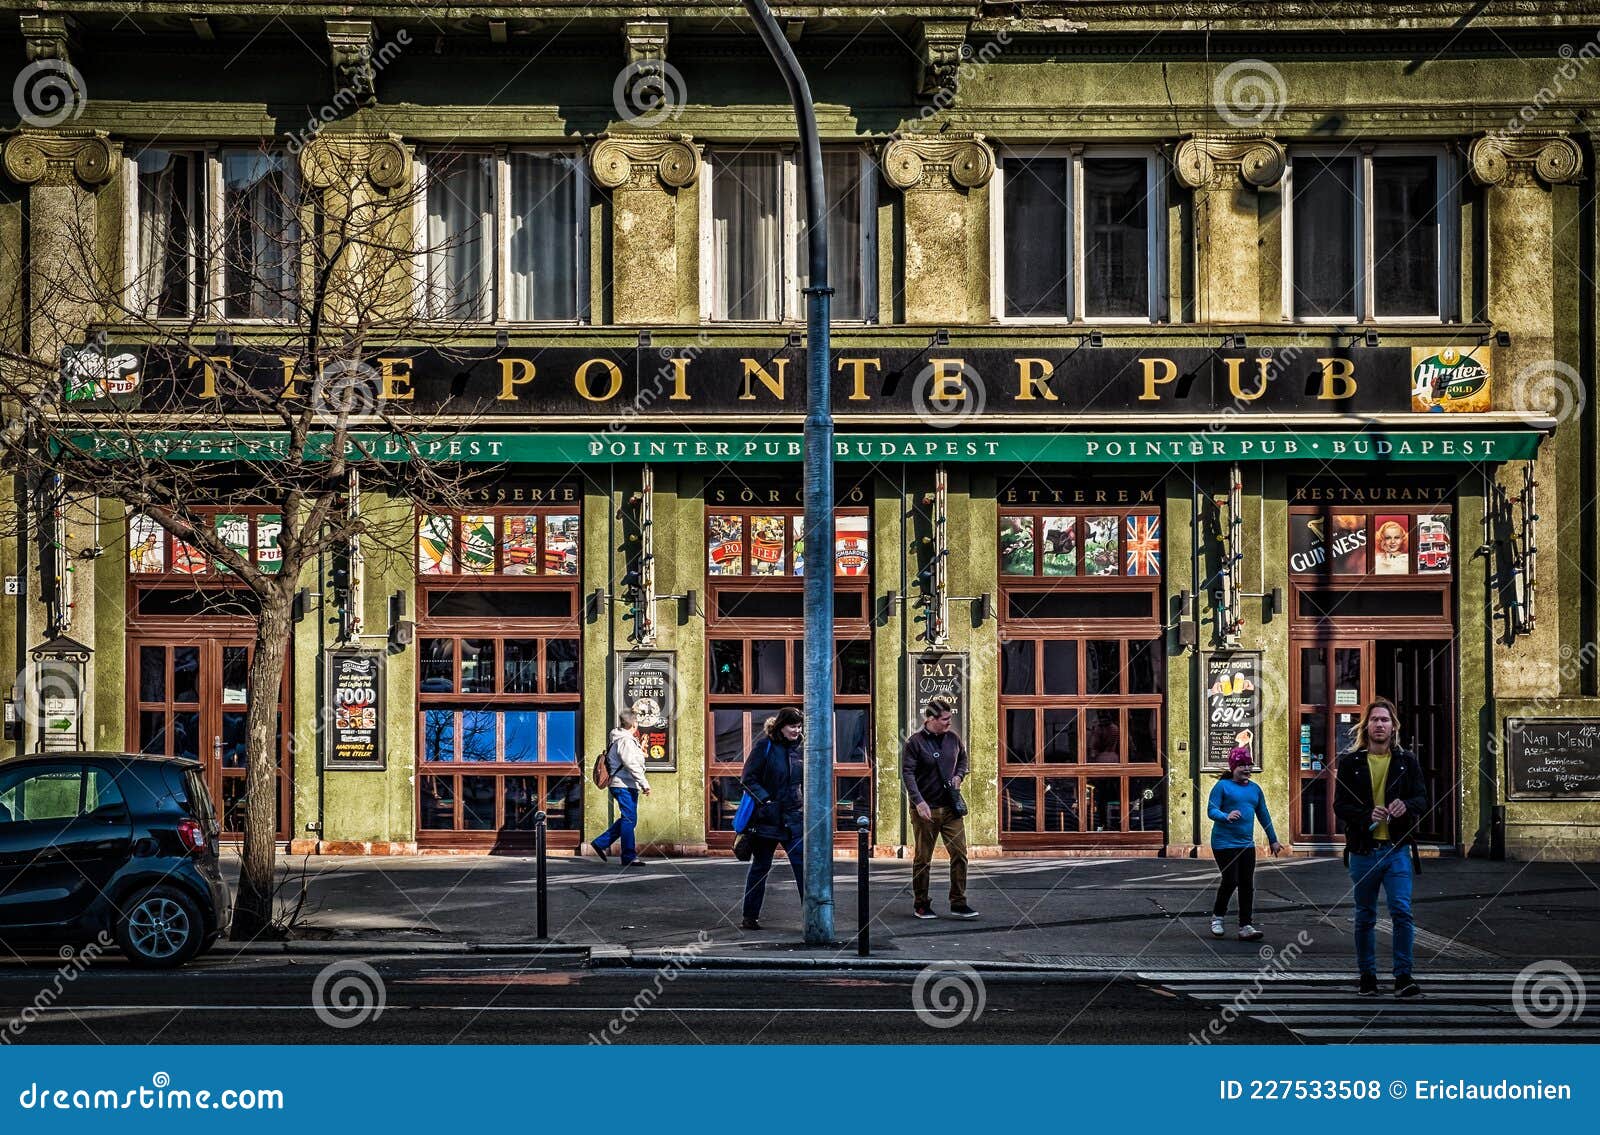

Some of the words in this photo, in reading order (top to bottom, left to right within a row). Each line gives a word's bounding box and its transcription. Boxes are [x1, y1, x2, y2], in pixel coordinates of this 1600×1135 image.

[187, 355, 415, 400] THE
[498, 357, 1059, 401] POINTER
[1138, 358, 1358, 401] PUB
[341, 441, 503, 455] BUDAPEST
[590, 441, 730, 456] POINTER
[744, 442, 801, 456] PUB
[835, 442, 999, 456] BUDAPEST
[1086, 441, 1226, 456] POINTER
[1240, 440, 1298, 454] PUB
[1332, 440, 1496, 455] BUDAPEST
[427, 488, 574, 501] BASSERIE
[1007, 487, 1154, 502] ÉTTEREM
[1296, 487, 1446, 500] RESTAURANT
[922, 663, 957, 677] EAT
[1210, 661, 1230, 669] HAPPY
[628, 677, 664, 686] SPORTS
[920, 677, 957, 693] Drink
[335, 688, 377, 705] FOOD
[628, 689, 664, 697] SCREENS
